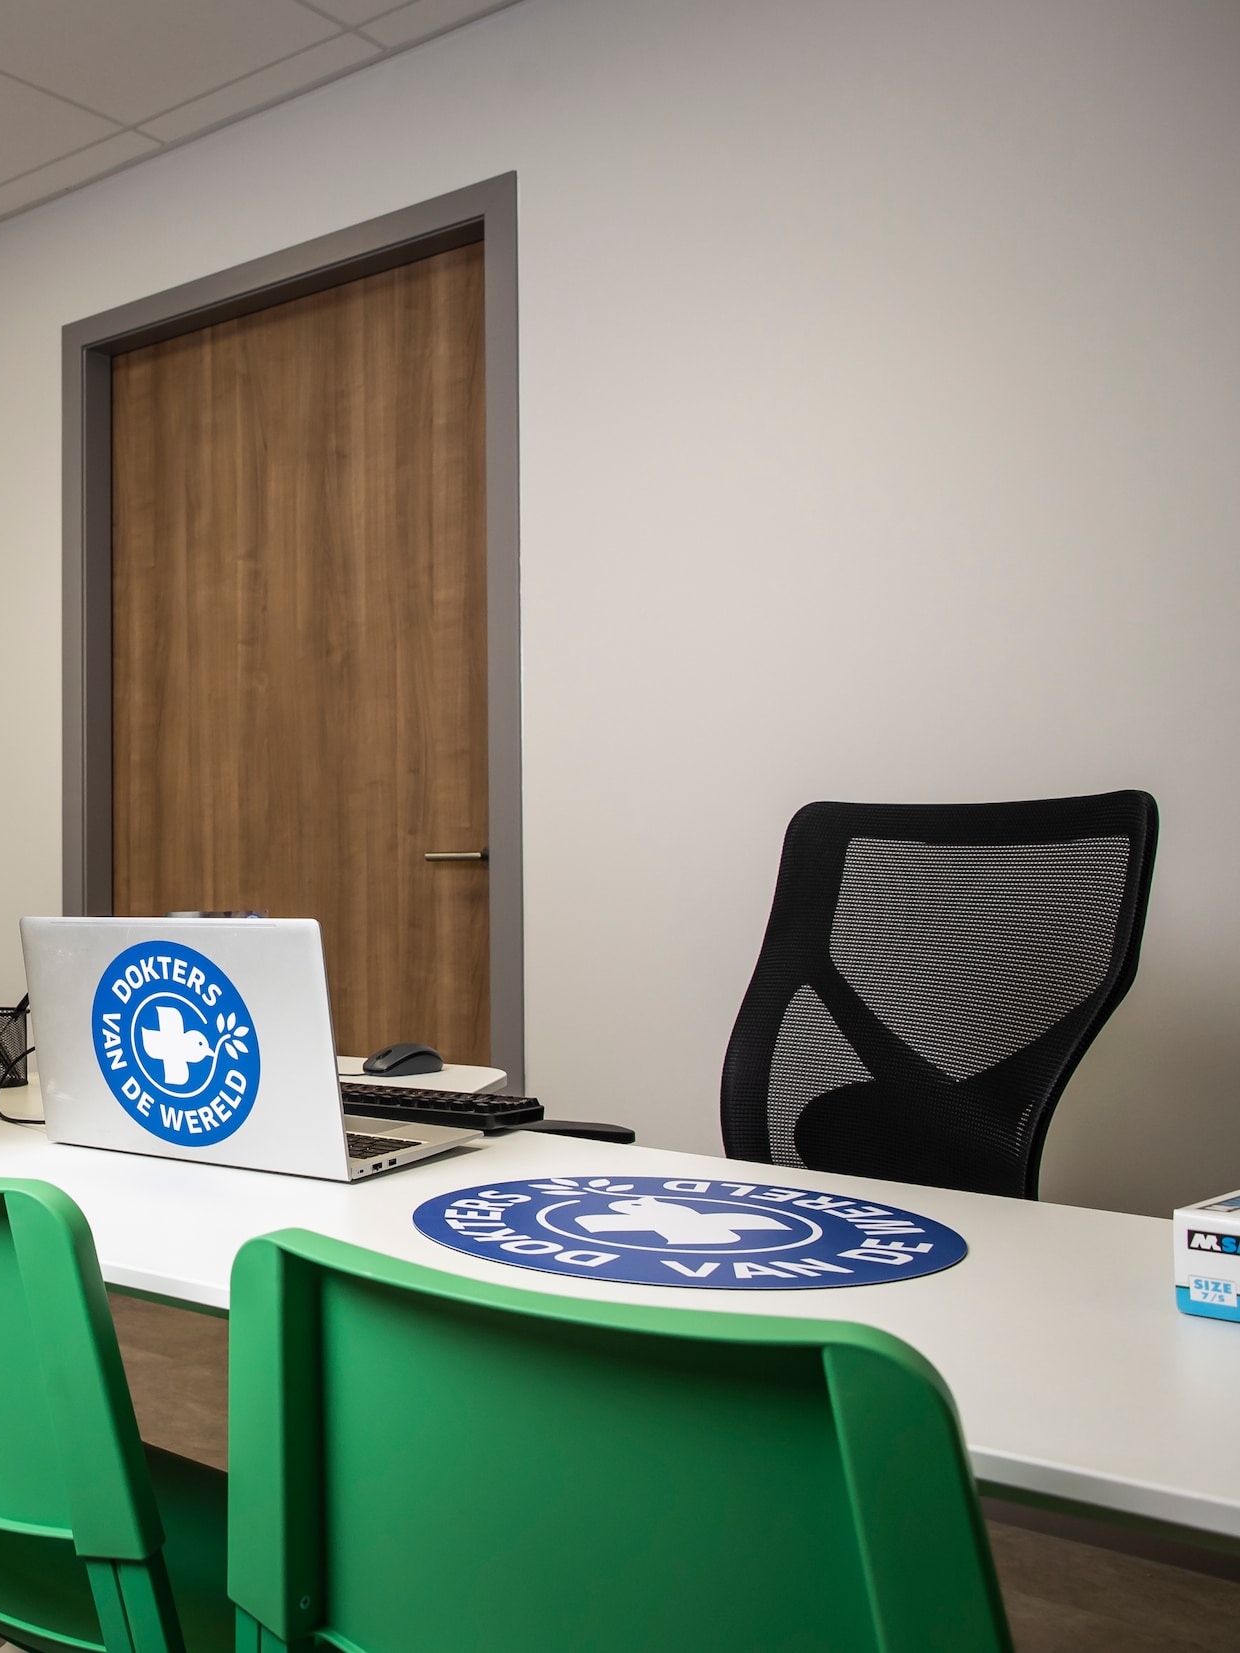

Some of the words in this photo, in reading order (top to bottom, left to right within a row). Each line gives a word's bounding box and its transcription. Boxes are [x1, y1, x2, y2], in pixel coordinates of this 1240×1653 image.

[112, 956, 222, 1006] DOKTERS
[102, 1013, 127, 1071] VAN
[121, 1076, 155, 1117] DE
[159, 1069, 247, 1134] WERELD
[662, 1180, 926, 1236] WERELD
[444, 1190, 620, 1267] DOKTERS
[1190, 1233, 1240, 1253] MS
[660, 1258, 854, 1279] VAN
[837, 1238, 934, 1265] DE
[1194, 1279, 1232, 1294] SIZE
